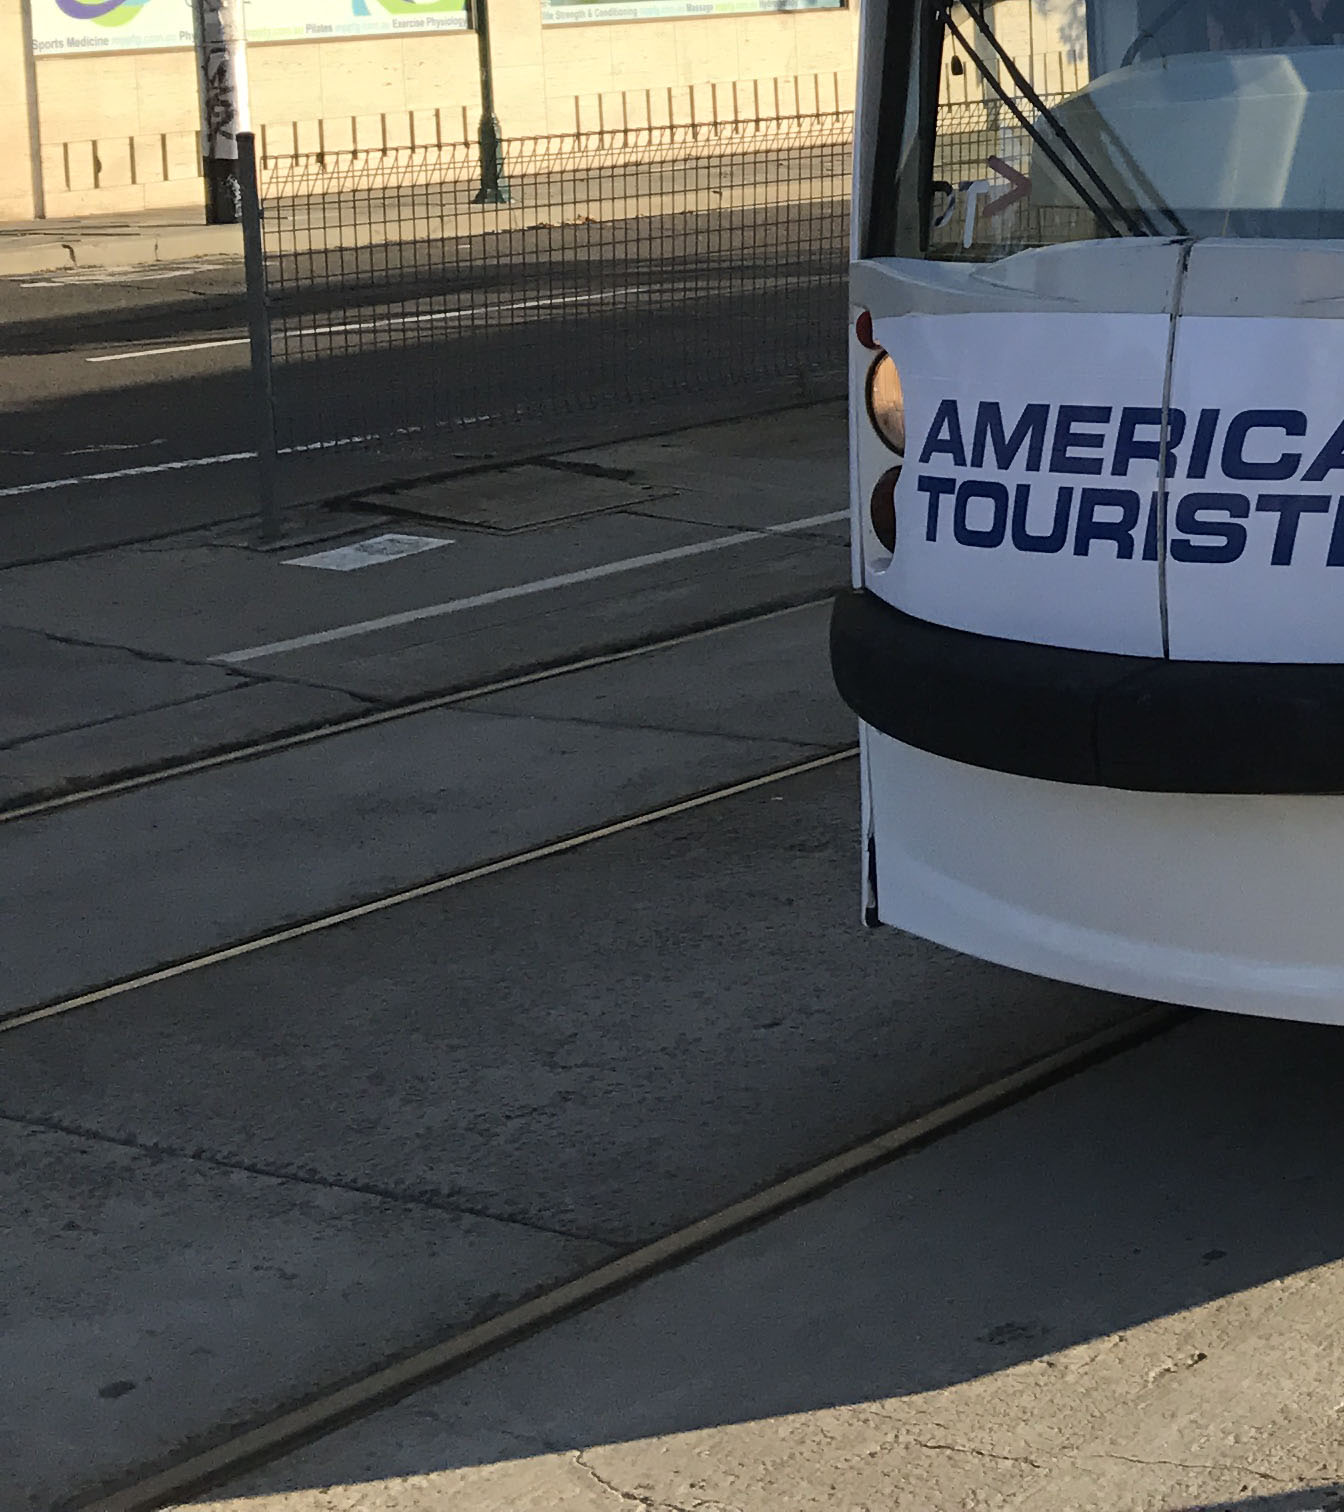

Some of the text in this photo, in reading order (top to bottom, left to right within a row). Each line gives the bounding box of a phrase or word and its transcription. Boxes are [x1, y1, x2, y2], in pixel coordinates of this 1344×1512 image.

[555, 9, 586, 22] Strength
[587, 9, 593, 19] &
[594, 7, 638, 19] Conditioning
[306, 23, 333, 34] Pilates
[392, 18, 425, 29] Exercise
[426, 16, 468, 28] Physiology
[32, 39, 64, 51] Sports
[67, 36, 109, 48] Medicine
